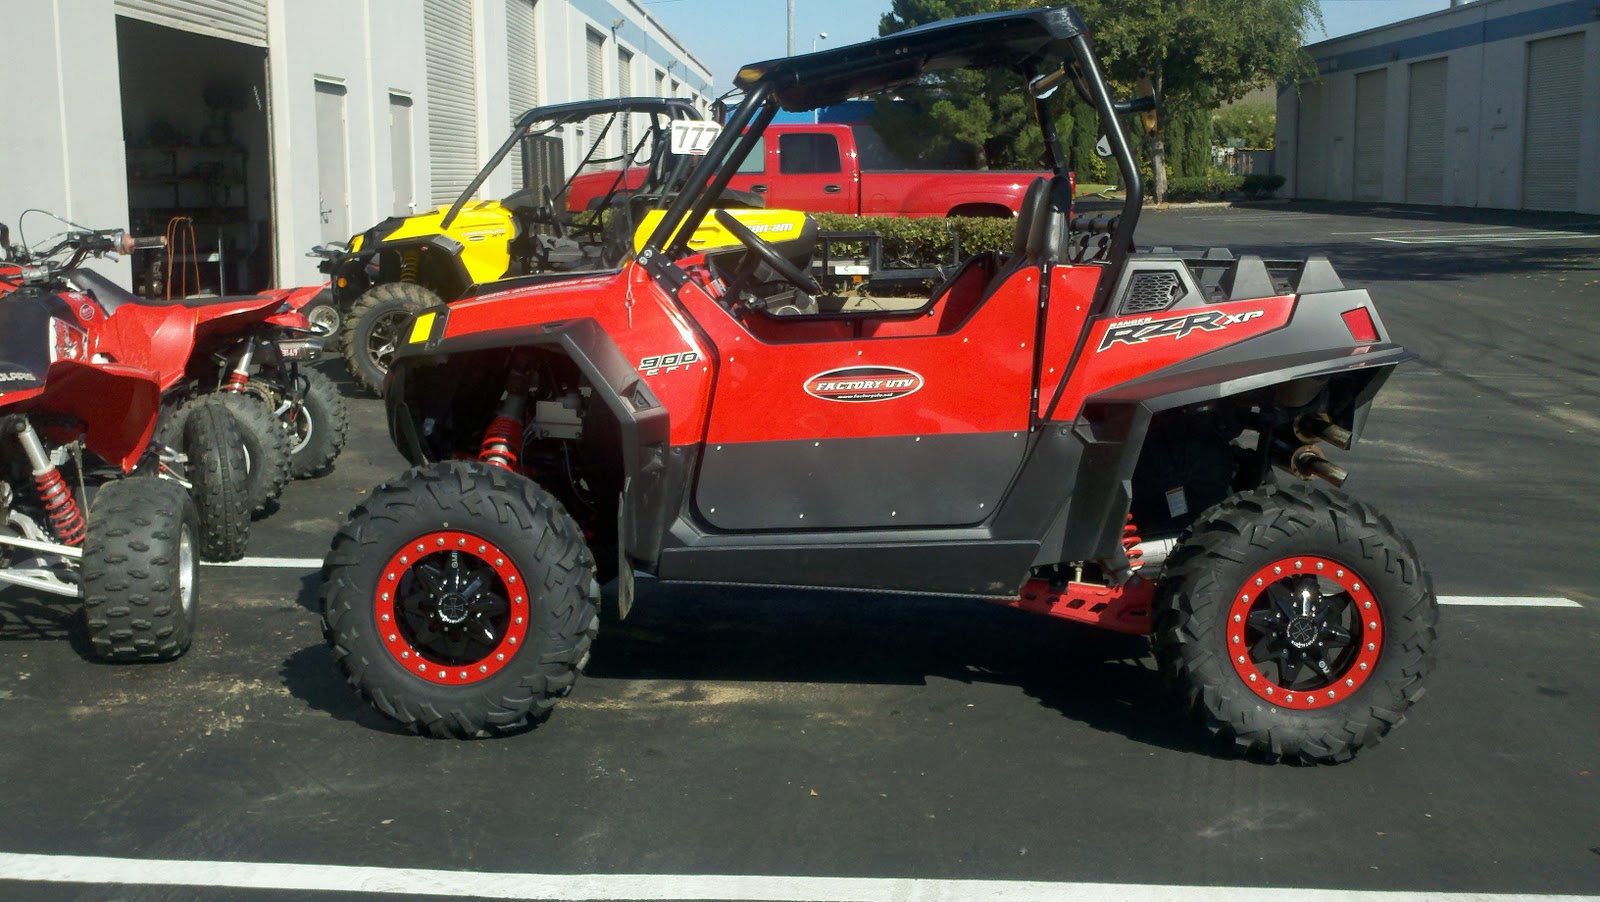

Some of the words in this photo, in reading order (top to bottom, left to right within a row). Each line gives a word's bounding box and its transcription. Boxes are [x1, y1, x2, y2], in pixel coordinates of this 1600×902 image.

[675, 126, 719, 148] 777
[1096, 310, 1226, 353] RZR
[1222, 310, 1265, 326] XP
[1109, 317, 1153, 330] RANGER
[638, 351, 699, 371] 900
[815, 380, 884, 391] FACTORY
[885, 379, 915, 388] UTV
